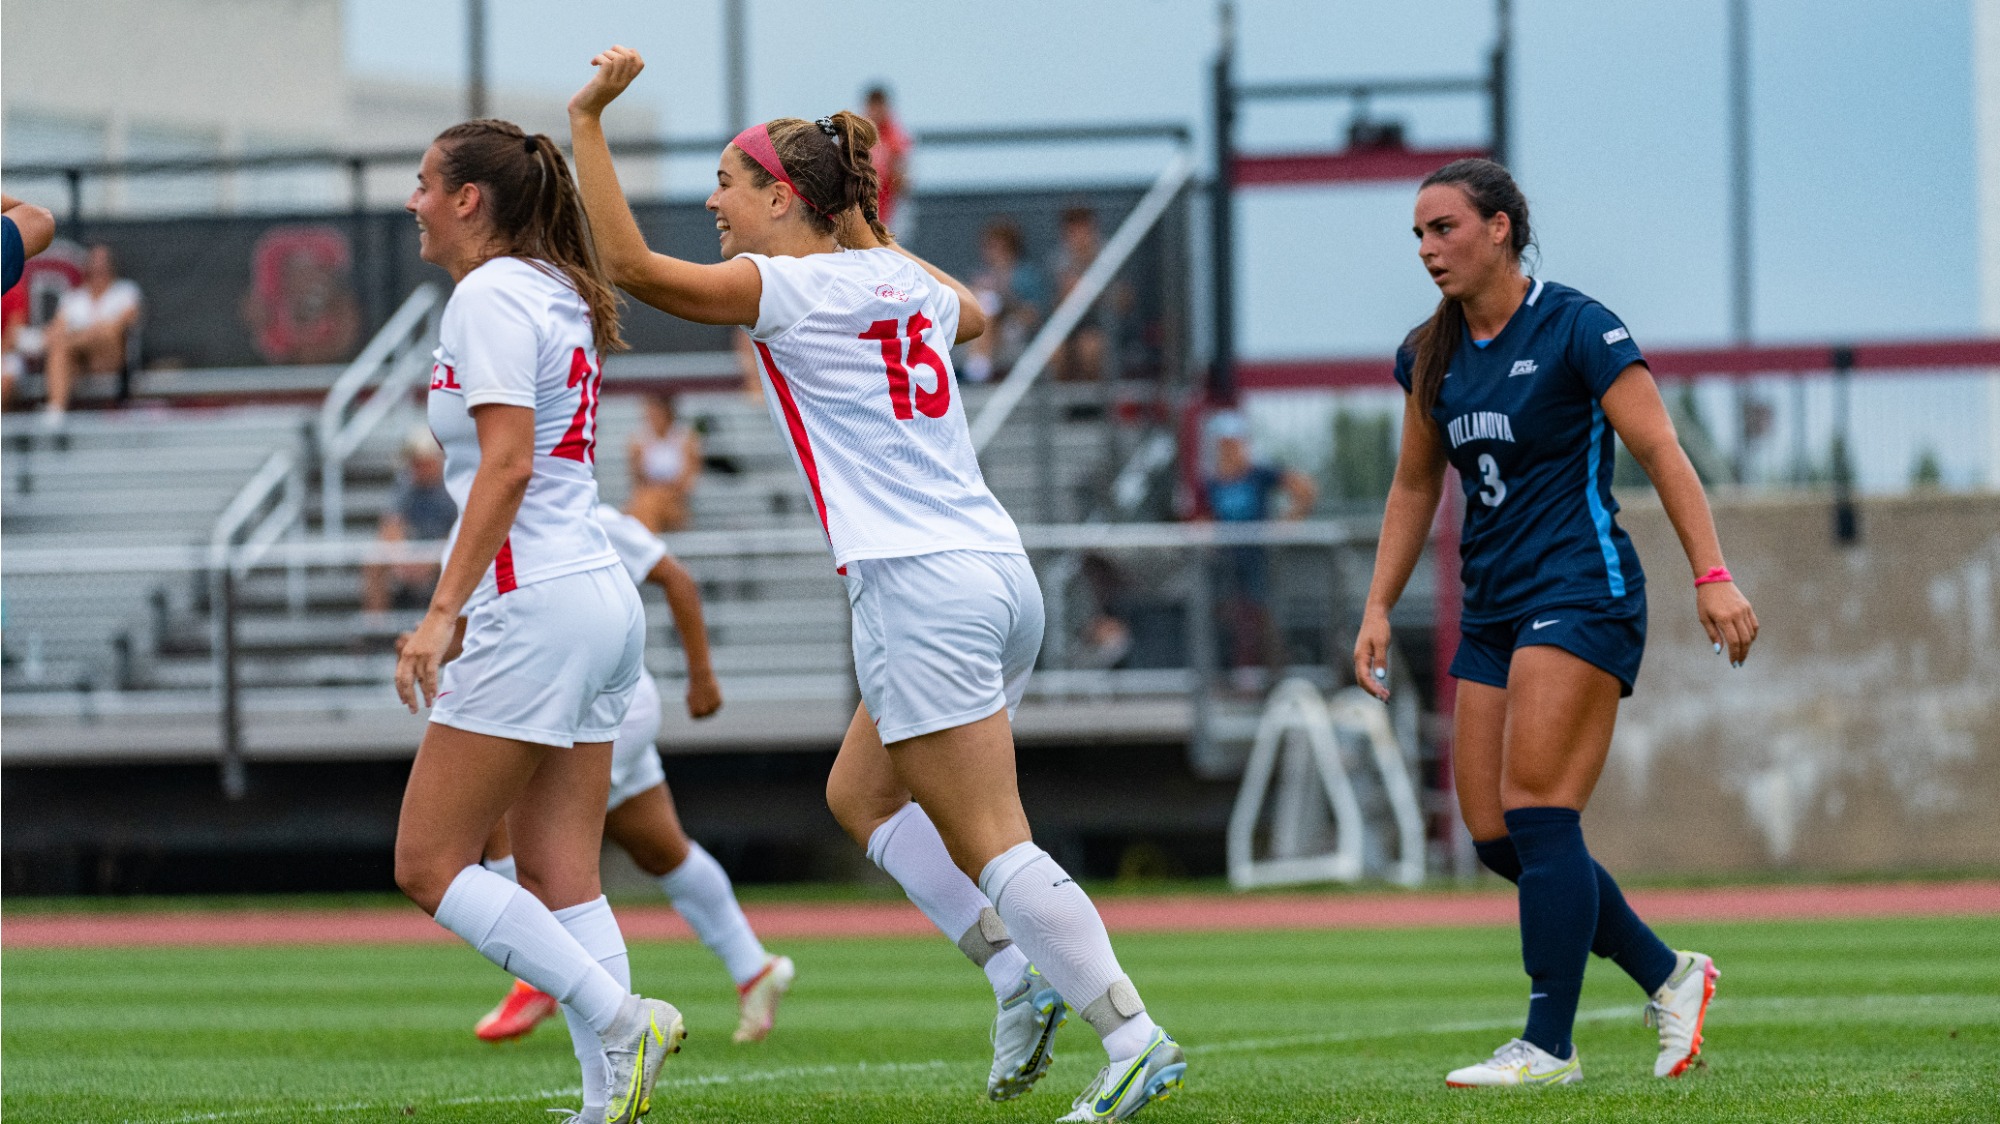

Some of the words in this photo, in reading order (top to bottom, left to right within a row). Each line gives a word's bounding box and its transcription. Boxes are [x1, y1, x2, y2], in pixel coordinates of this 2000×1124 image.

[858, 309, 950, 420] 15
[1447, 411, 1516, 449] VILLANOVA
[1477, 453, 1507, 507] 3
